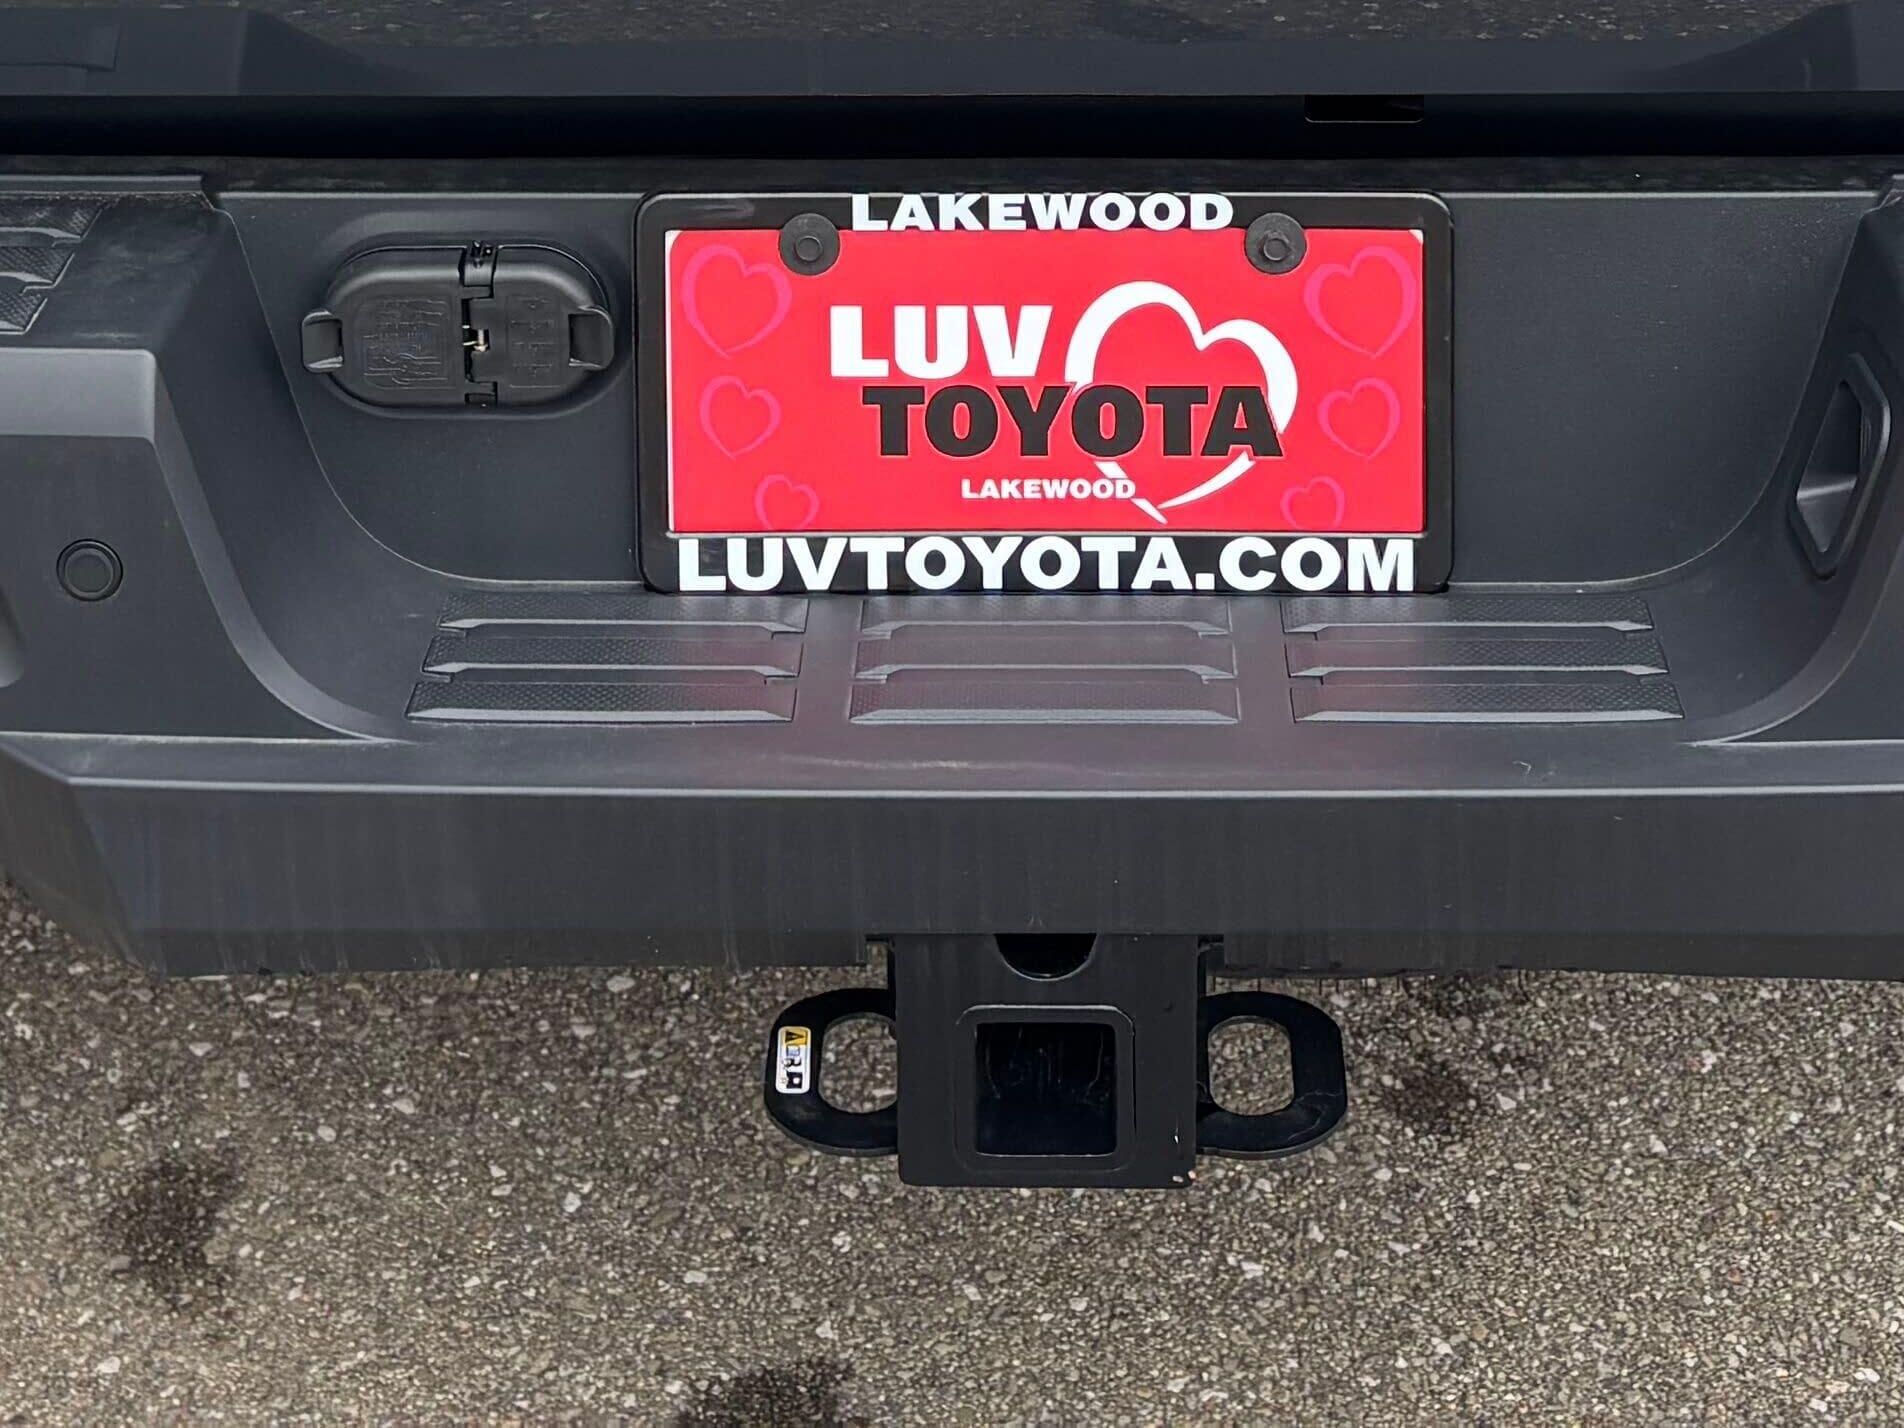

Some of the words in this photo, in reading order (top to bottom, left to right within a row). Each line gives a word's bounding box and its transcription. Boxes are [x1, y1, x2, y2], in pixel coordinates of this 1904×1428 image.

[851, 192, 1234, 232] LAKEWOOD
[829, 304, 1054, 379] LUV
[862, 384, 1284, 459] TOYOTA
[961, 478, 1137, 500] LAKEWOOD
[678, 536, 1415, 592] LUVTOYOTA.COM
